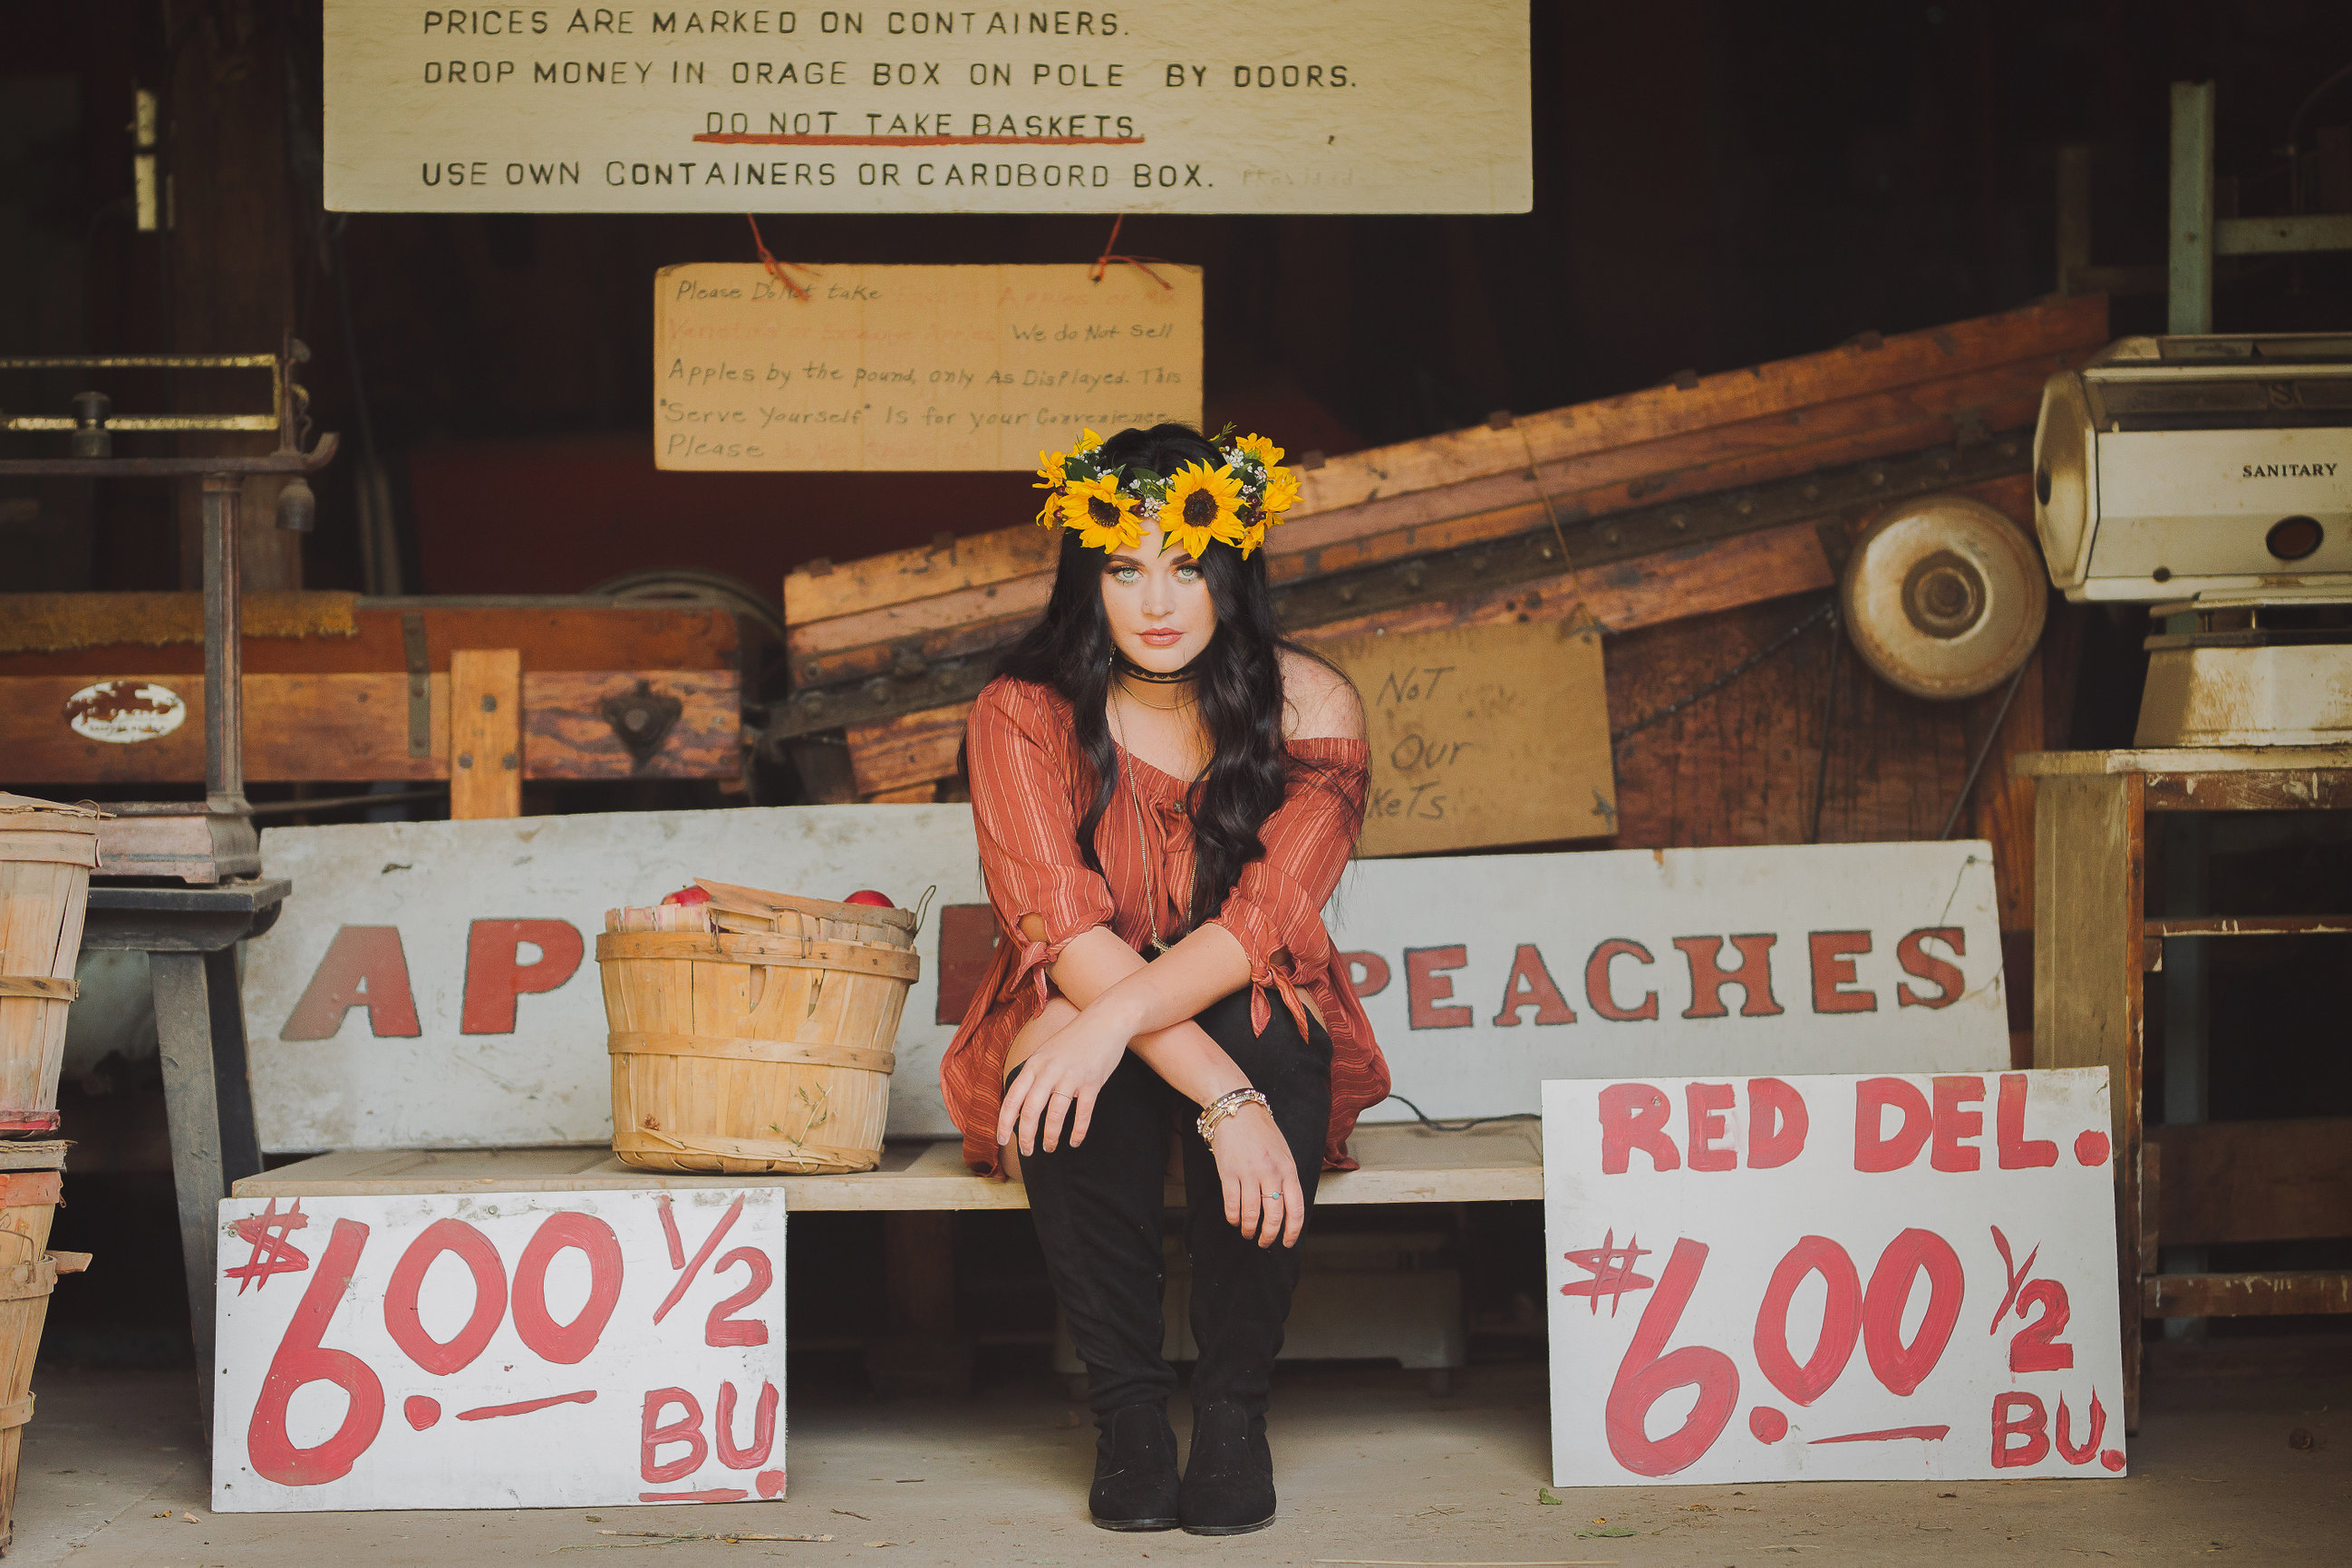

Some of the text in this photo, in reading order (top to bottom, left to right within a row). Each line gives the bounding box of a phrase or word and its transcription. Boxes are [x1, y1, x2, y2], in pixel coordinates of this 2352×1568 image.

[424, 8, 1128, 36] PRICES ARE MARKED ON CONTAINERS.
[424, 61, 1356, 88] DROP MONEY IN ORAGE BOX ON POLE BY DOORS.
[707, 111, 749, 134] DO
[769, 111, 837, 134] NOT
[866, 113, 953, 136] TAKE
[422, 160, 1213, 188] USE OWN CONTAINERS OR CARDBORD BOX.
[676, 280, 742, 301] Please
[827, 282, 882, 300] take
[1011, 324, 1045, 342] We
[1054, 324, 1078, 341] do
[1085, 324, 1119, 342] Not
[668, 359, 755, 385] Apples
[766, 363, 791, 389] by
[803, 362, 843, 380] the
[986, 370, 1014, 384] As
[921, 407, 956, 427] for
[667, 433, 765, 458] Please
[2242, 463, 2338, 479] SANITARY
[1367, 780, 1447, 820] KeTs
[1338, 925, 1967, 1031] PEACHES
[1598, 1073, 2111, 1174] RED DEL.
[1990, 1385, 2127, 1473] BU.
